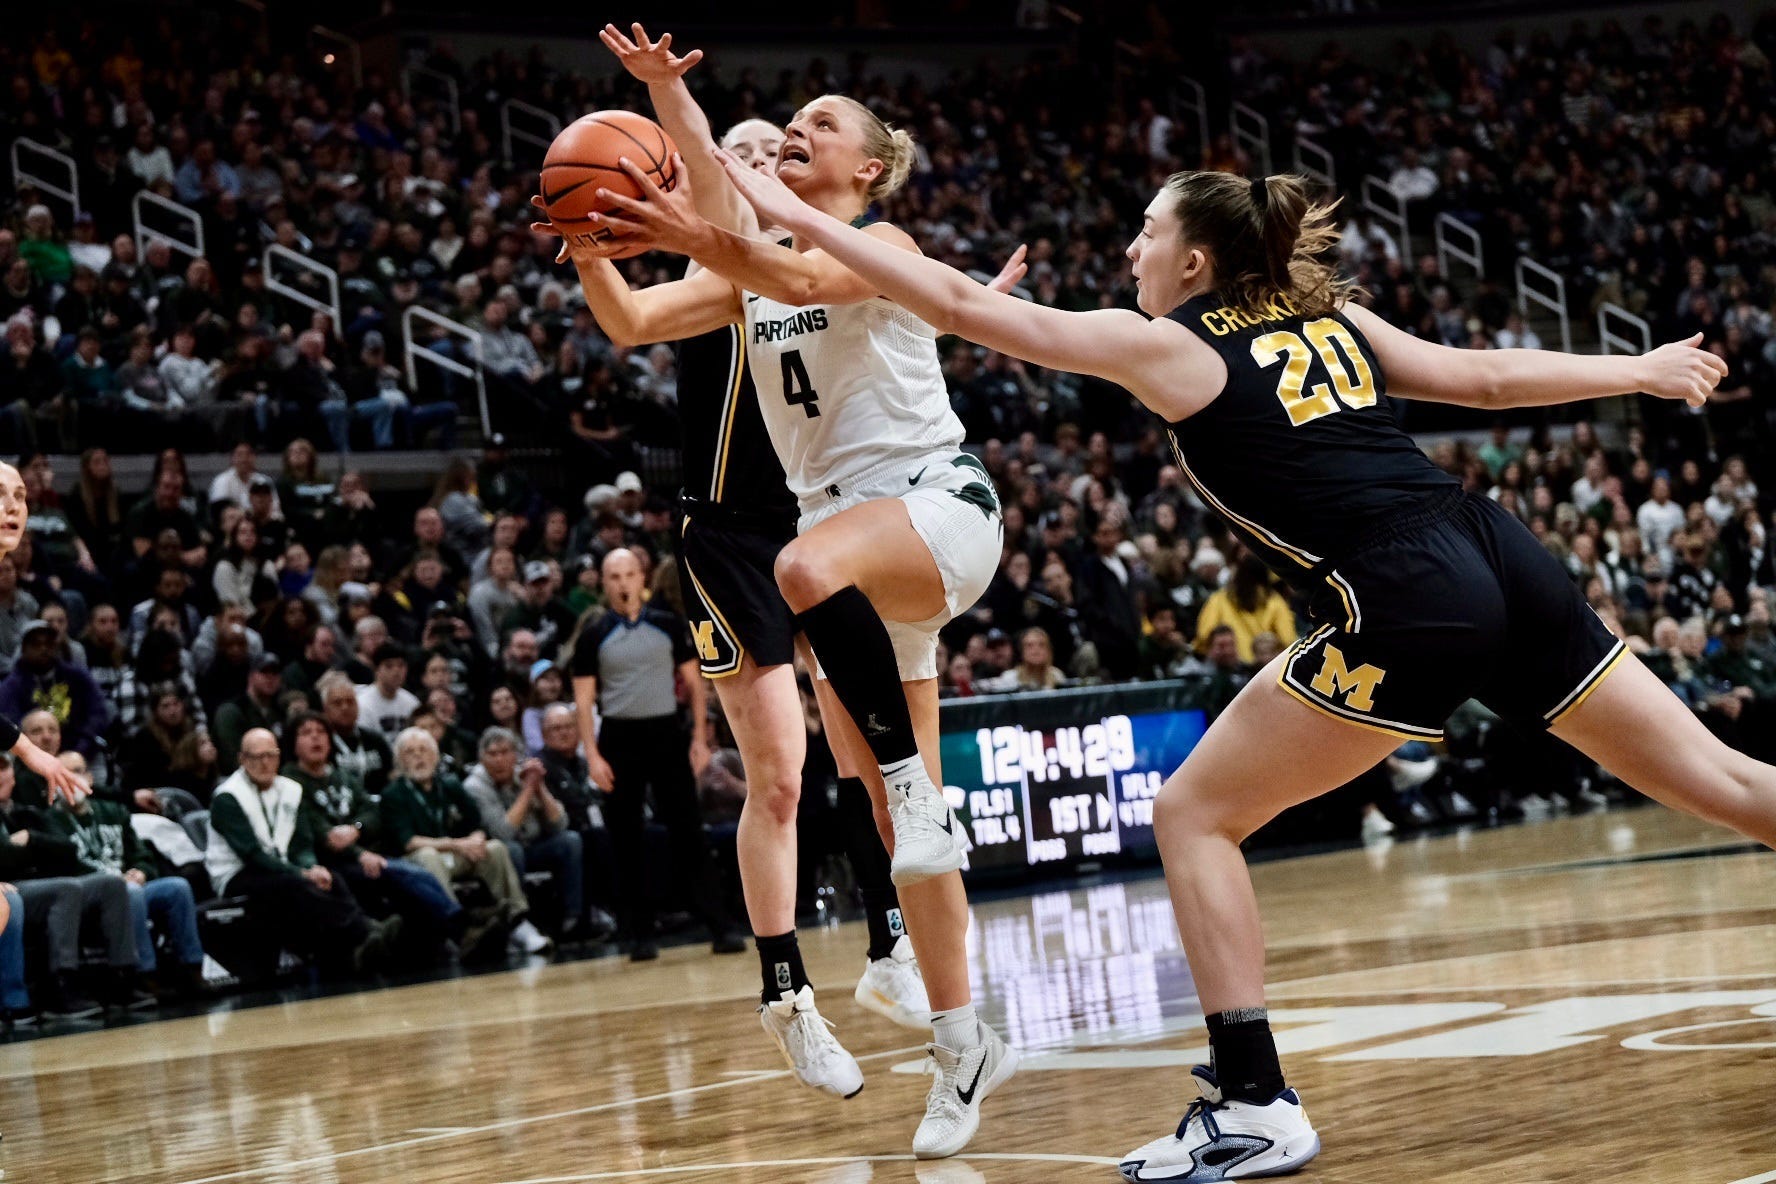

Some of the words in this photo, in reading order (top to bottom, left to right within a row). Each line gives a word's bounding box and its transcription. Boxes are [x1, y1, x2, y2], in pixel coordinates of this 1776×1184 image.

[780, 349, 821, 419] 4
[1250, 317, 1377, 427] 20
[689, 620, 720, 660] M
[1310, 643, 1387, 712] M
[1049, 794, 1092, 834] 1ST
